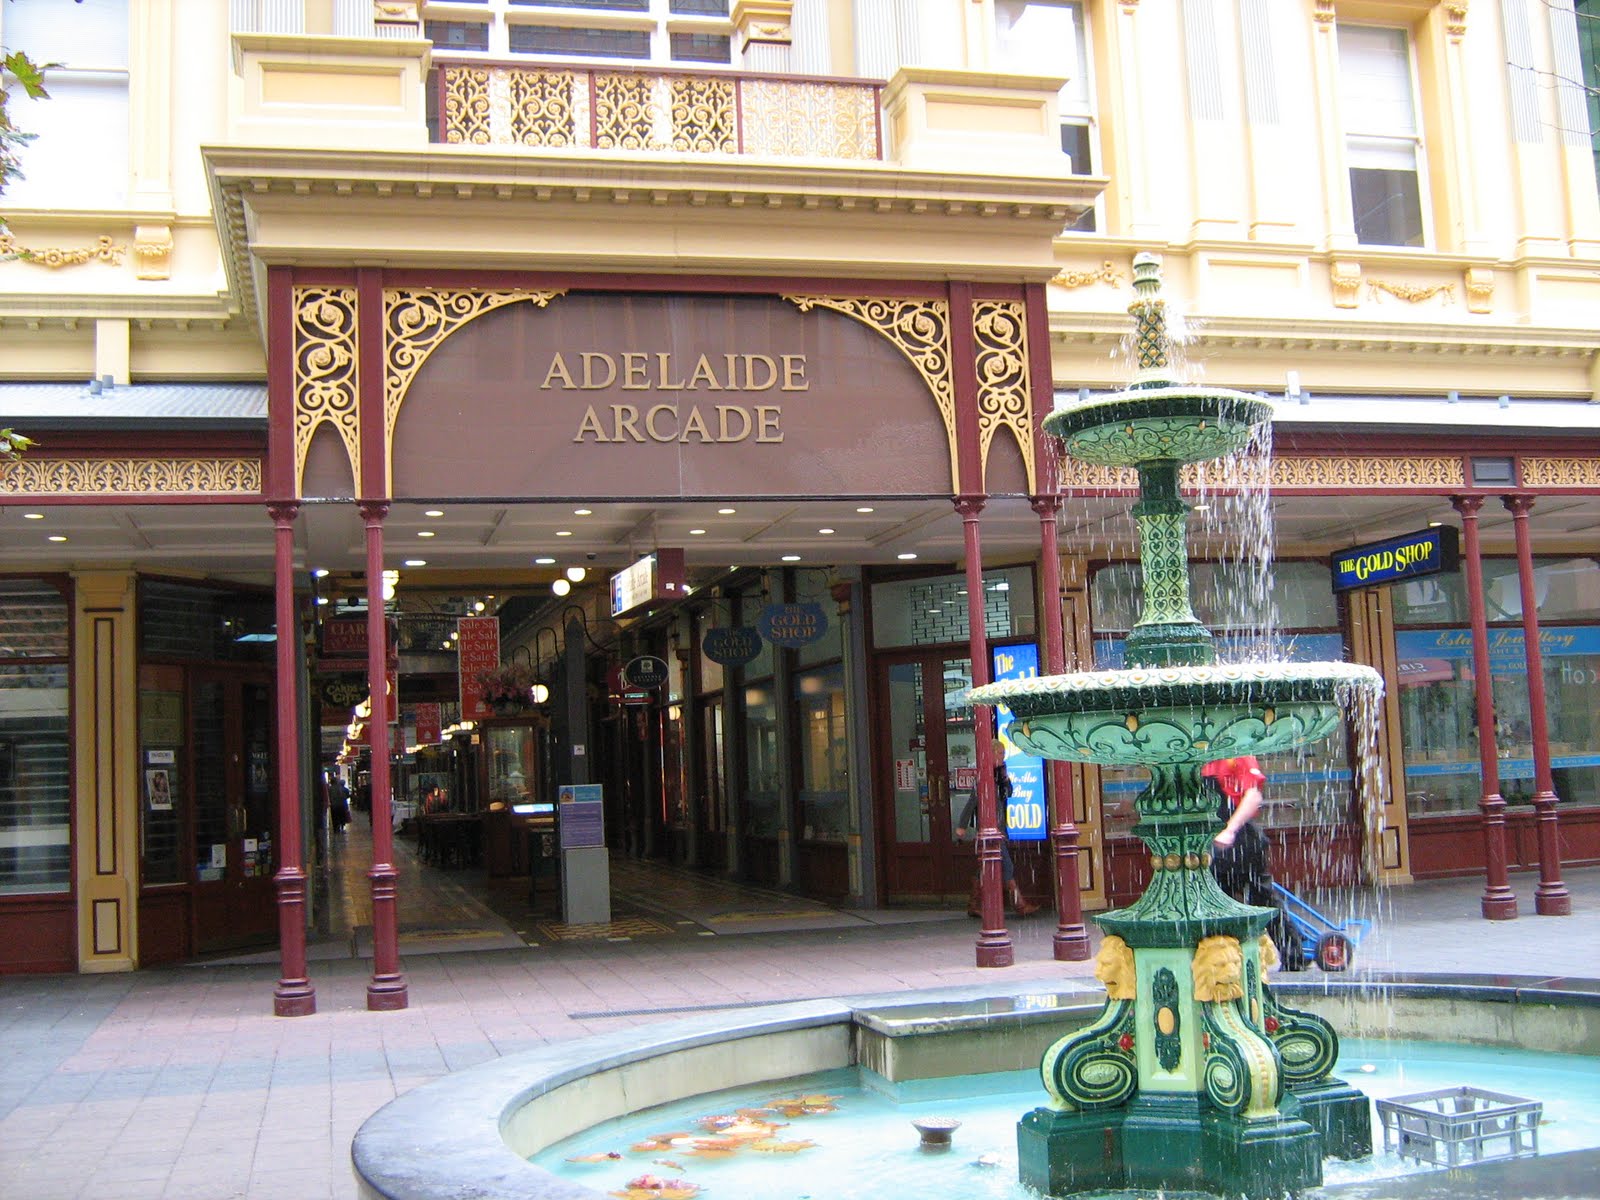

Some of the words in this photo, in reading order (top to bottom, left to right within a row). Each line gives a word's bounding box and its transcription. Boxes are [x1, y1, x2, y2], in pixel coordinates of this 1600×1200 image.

[540, 351, 809, 391] ADELAIDE
[573, 404, 785, 443] ARCADE
[1340, 559, 1355, 573] THE
[1356, 551, 1393, 580] GOLD
[1395, 541, 1432, 571] SHOP
[482, 620, 497, 629] Sal
[770, 614, 817, 626] GOLD
[770, 627, 817, 639] SHOP
[1436, 632, 1472, 646] Esta
[1490, 631, 1577, 648] Jewllery
[712, 647, 753, 657] SHOP
[995, 653, 1014, 675] The
[1012, 785, 1032, 803] Buy
[1006, 803, 1042, 829] GOLD
